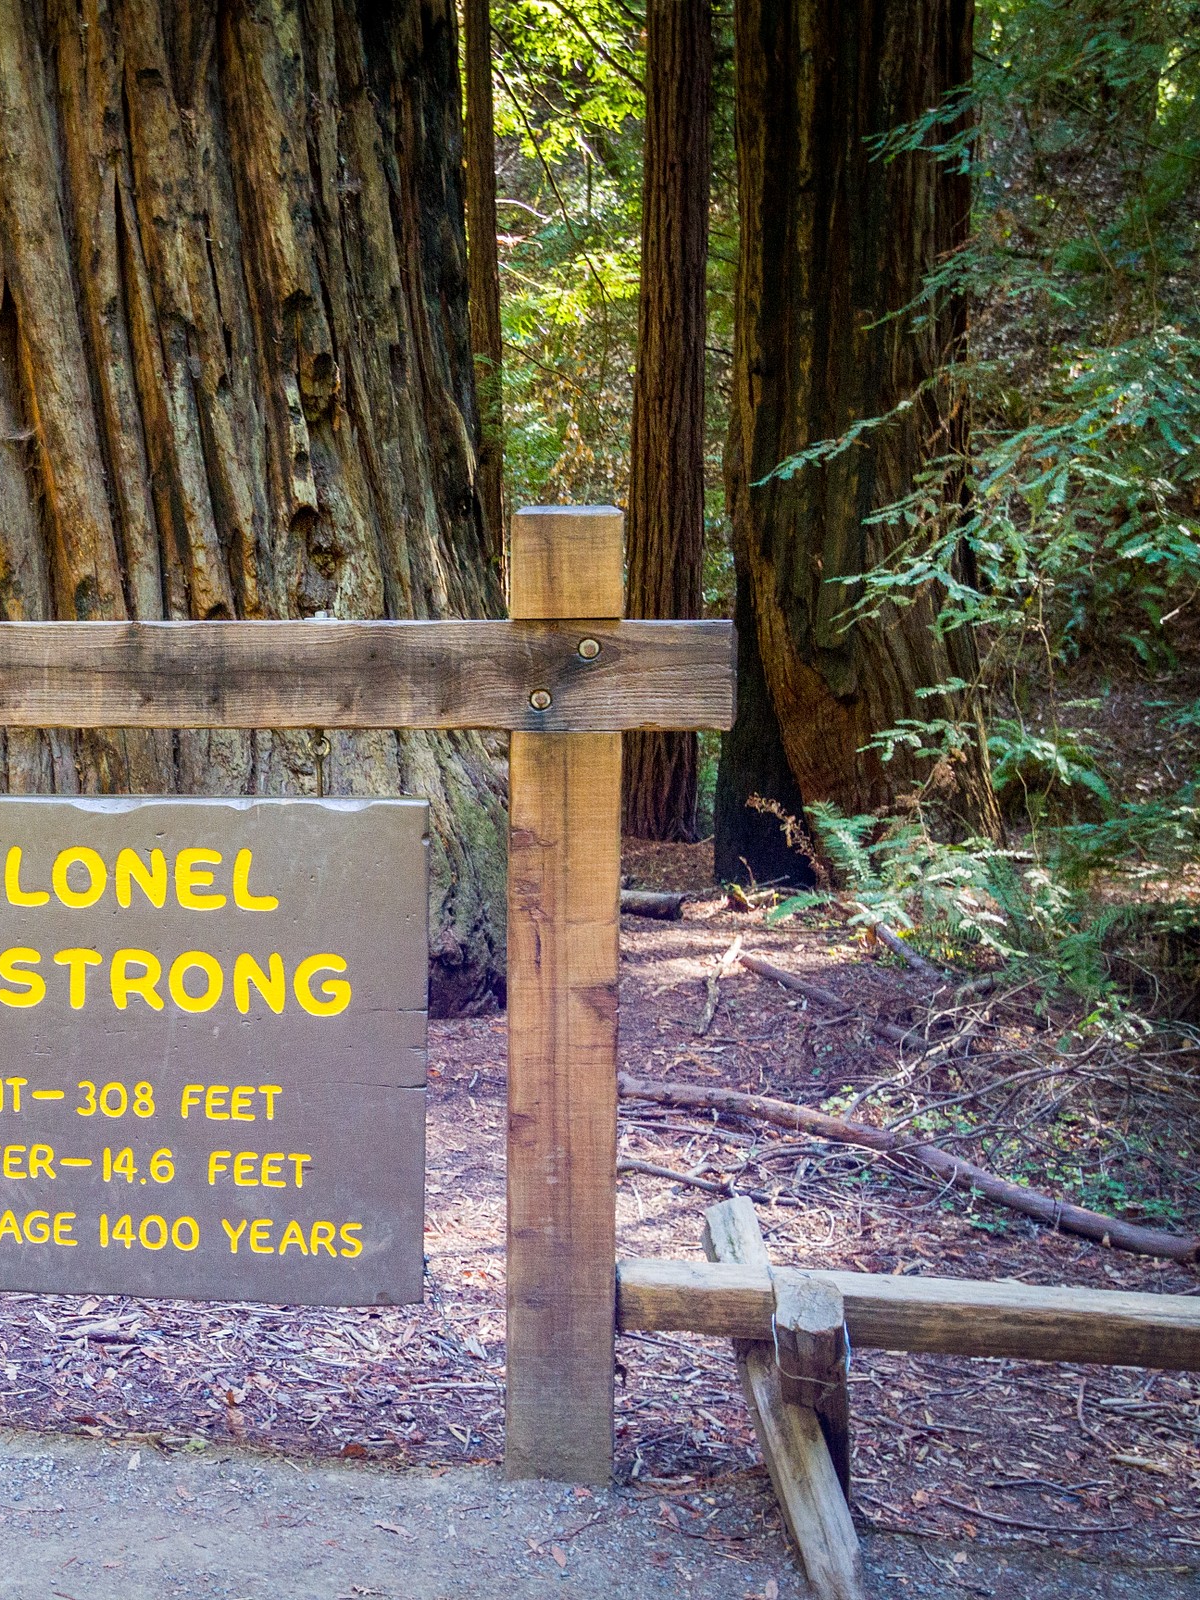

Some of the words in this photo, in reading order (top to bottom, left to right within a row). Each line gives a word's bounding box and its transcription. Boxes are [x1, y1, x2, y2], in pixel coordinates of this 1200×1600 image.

[180, 1084, 283, 1121] FEET
[207, 1149, 312, 1188] FEET
[99, 1213, 201, 1251] 1400
[221, 1218, 363, 1258] YEARS
